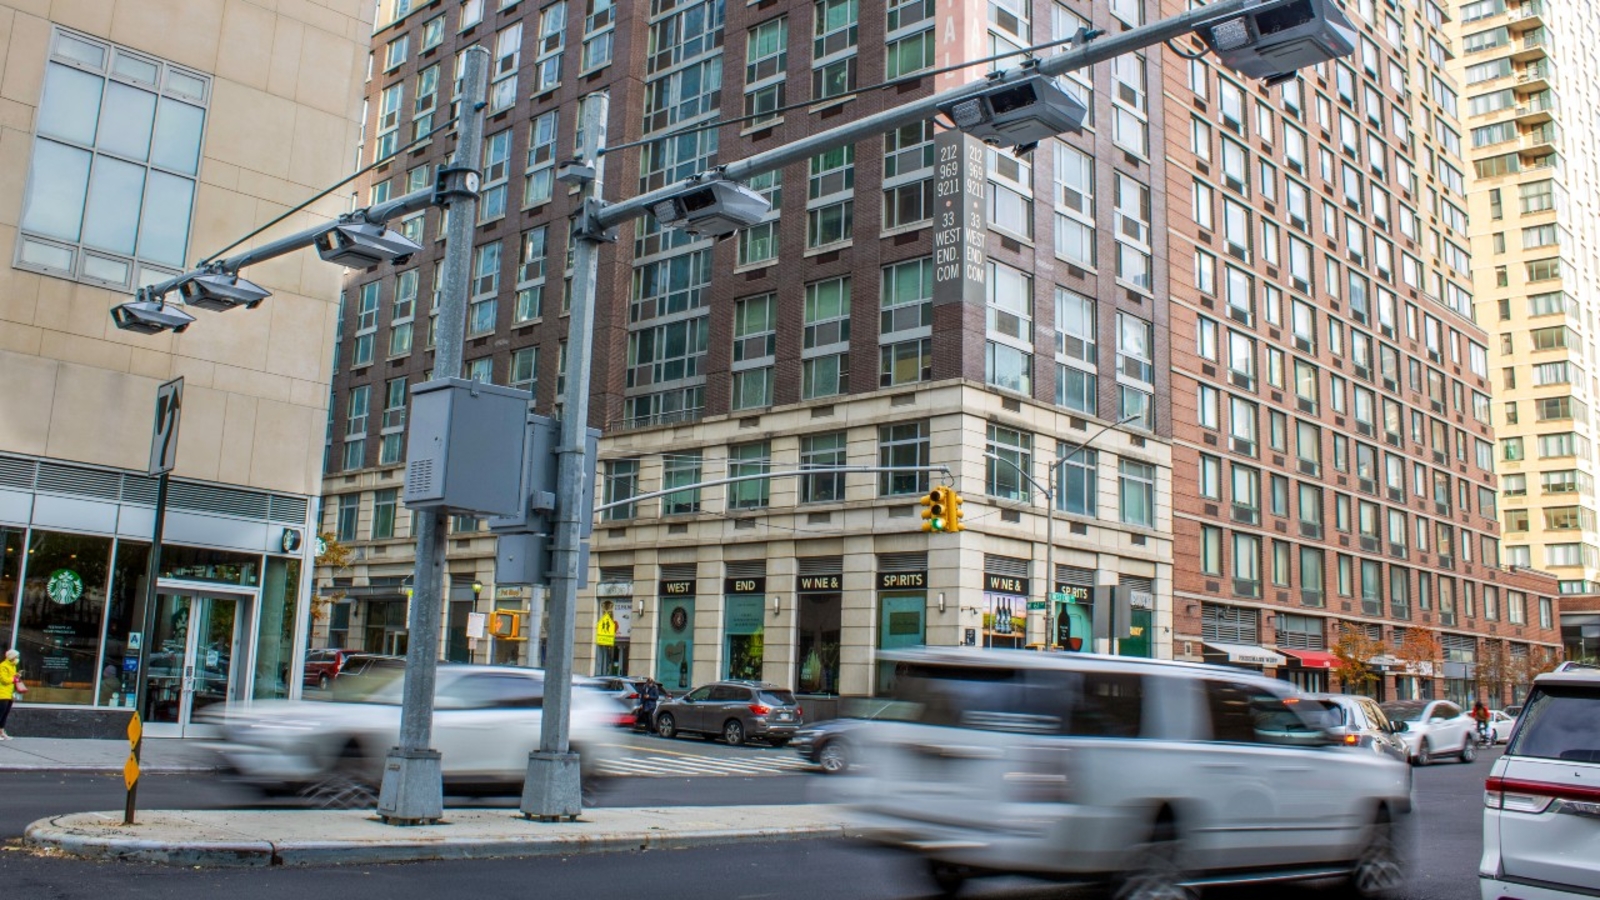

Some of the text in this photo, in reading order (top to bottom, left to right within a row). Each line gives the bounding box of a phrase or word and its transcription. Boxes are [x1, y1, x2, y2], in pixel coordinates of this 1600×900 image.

[941, 144, 957, 161] 212
[969, 144, 982, 164] 212
[940, 161, 958, 179] 969
[969, 161, 983, 181] 969
[937, 178, 959, 196] 9211
[967, 178, 984, 199] 9211
[942, 211, 955, 228] 33
[970, 212, 981, 229] 33
[936, 227, 961, 246] WEST
[965, 227, 986, 248] WEST
[937, 246, 959, 264] END.
[937, 263, 959, 281] COM
[967, 264, 984, 283] COM
[666, 582, 691, 593] WEST
[735, 580, 756, 591] END
[830, 577, 839, 588] &
[883, 574, 923, 586] SPIRITS
[990, 576, 1013, 591] WNE
[1014, 580, 1022, 592] &
[130, 634, 139, 643] A
